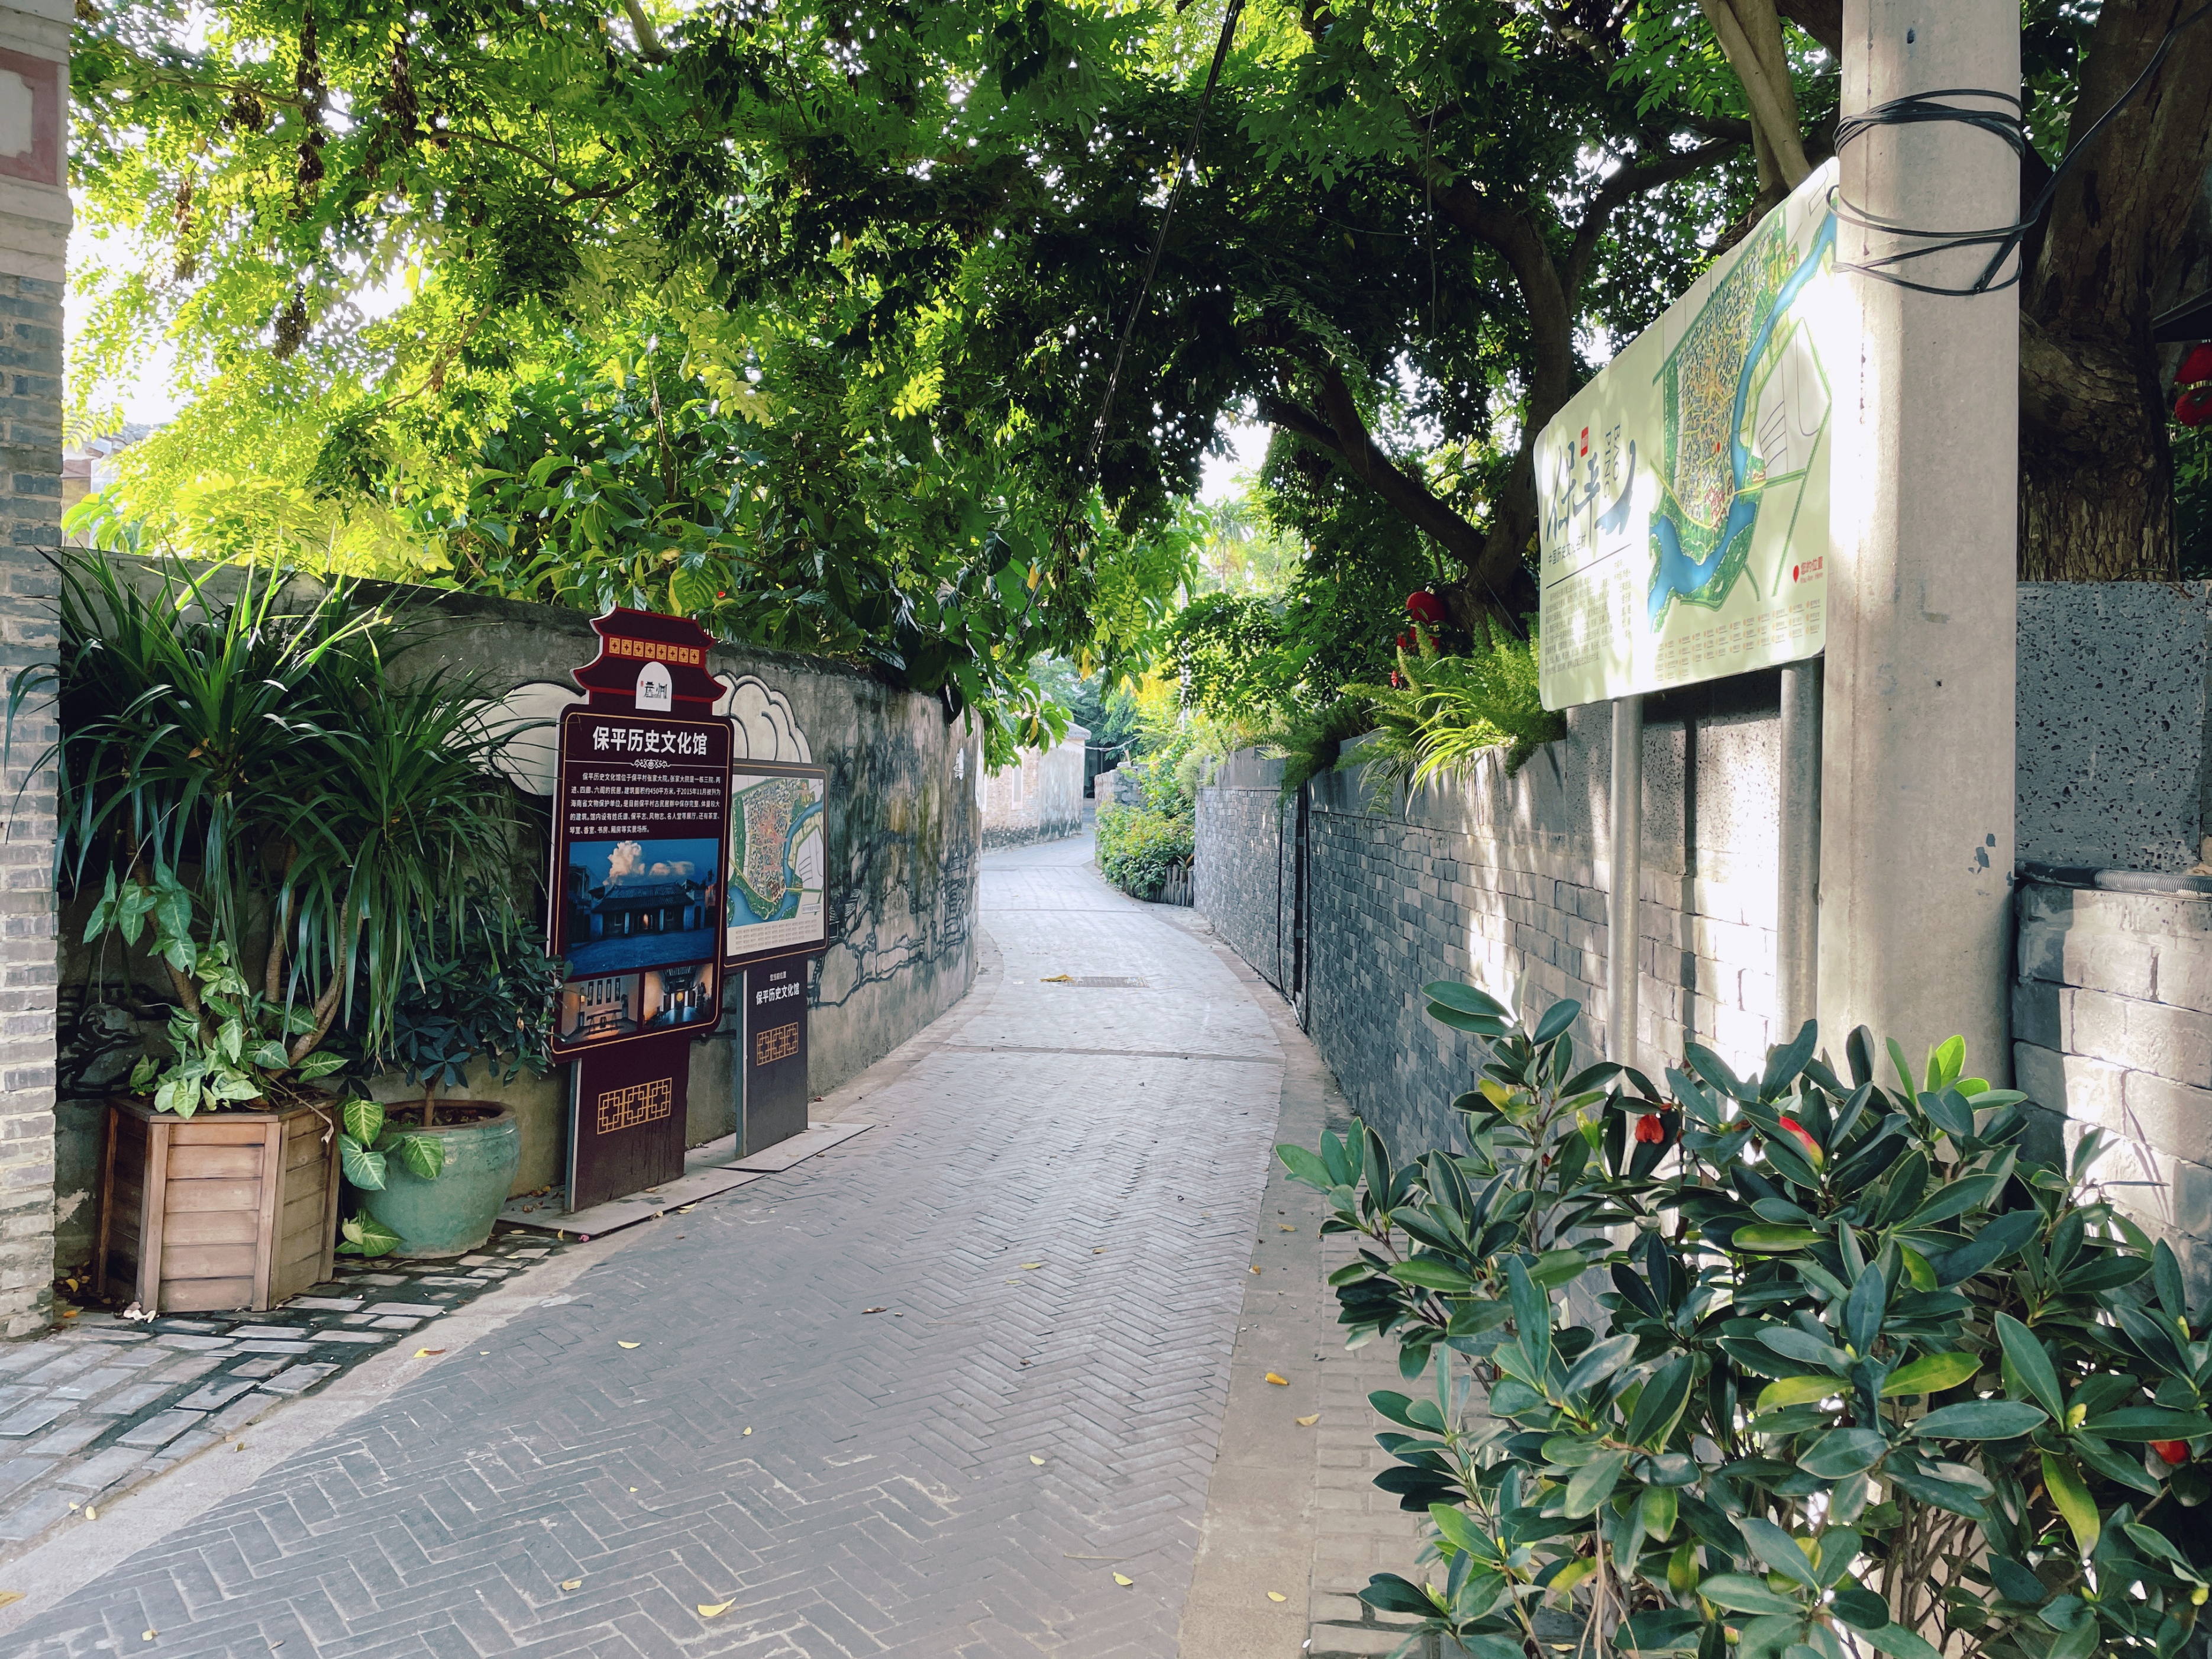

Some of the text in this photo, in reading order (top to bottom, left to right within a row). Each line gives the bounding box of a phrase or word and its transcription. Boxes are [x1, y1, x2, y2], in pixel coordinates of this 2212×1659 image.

[593, 725, 707, 756] 保平历史文化馆
[755, 982, 800, 1006] 保平历史文化馆
